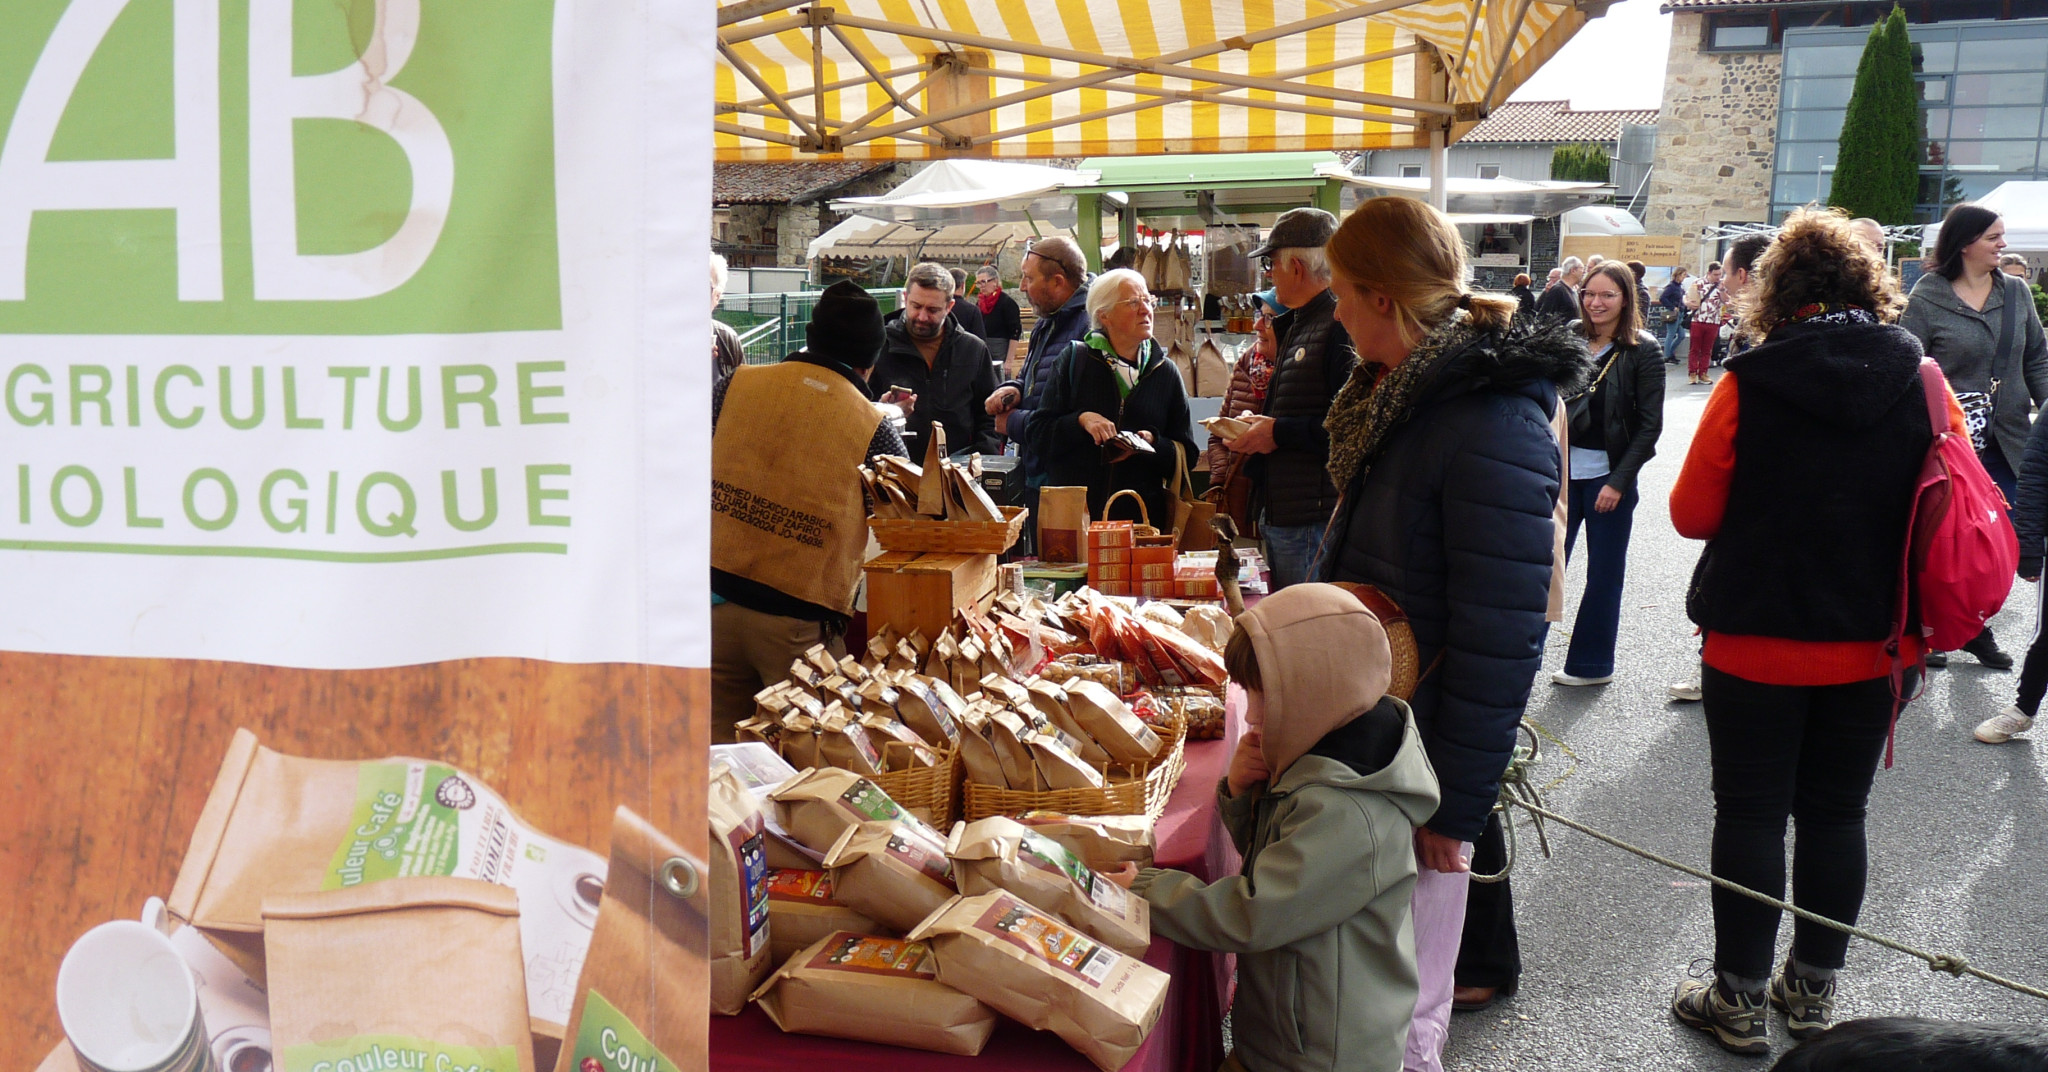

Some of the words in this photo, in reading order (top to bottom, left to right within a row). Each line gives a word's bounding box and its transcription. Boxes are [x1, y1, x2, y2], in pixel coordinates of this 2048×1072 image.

[0, 0, 455, 302] AB
[4, 360, 571, 433] GRICULTURE
[16, 463, 573, 539] IOLOGIQUE
[712, 480, 752, 501] WASHED
[753, 494, 789, 517] MEXICO
[789, 509, 833, 531] ARABICA
[712, 490, 748, 512] ALTURA
[750, 504, 770, 520] SHG
[771, 513, 784, 525] EP
[355, 791, 402, 836] Café
